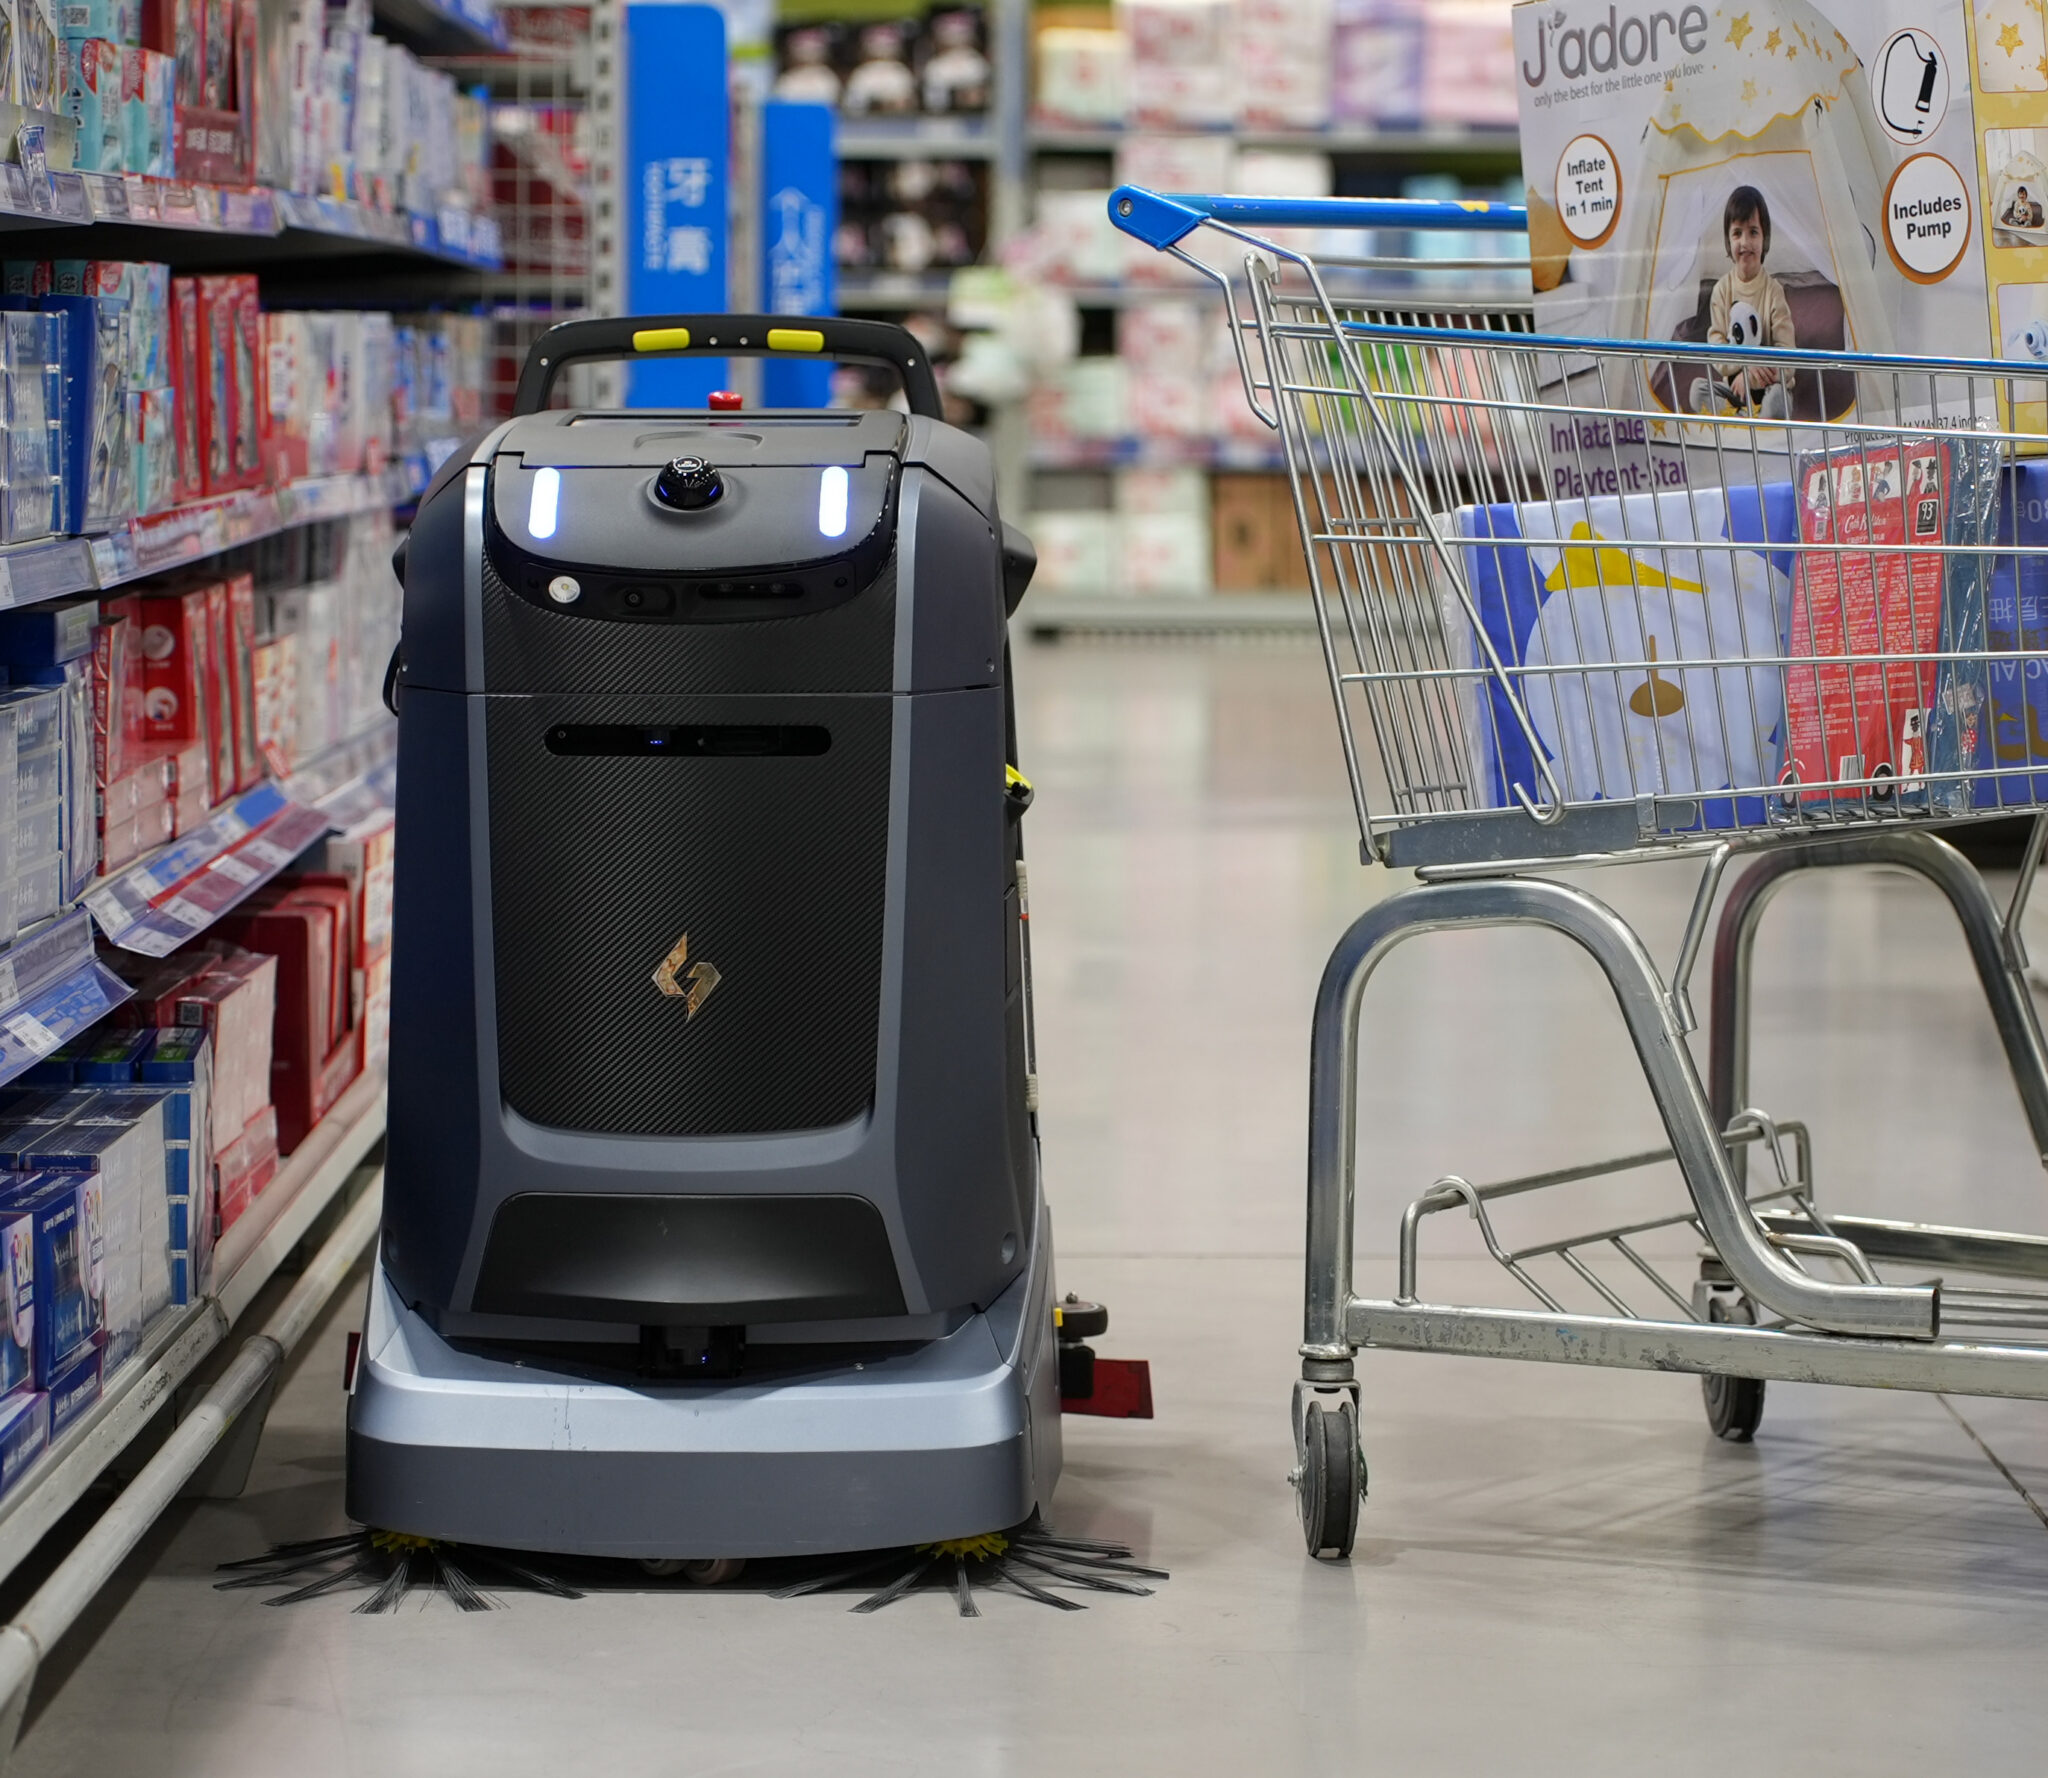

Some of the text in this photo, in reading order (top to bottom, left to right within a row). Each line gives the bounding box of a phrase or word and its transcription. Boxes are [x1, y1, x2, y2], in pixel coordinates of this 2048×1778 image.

[1523, 4, 1708, 87] J'adore
[1534, 64, 1703, 108] only the best for the little one you love
[1567, 158, 1606, 176] Inflate
[1576, 178, 1603, 195] Tent
[1566, 196, 1613, 217] in 1 min
[1894, 196, 1962, 220] Includes
[1906, 221, 1951, 240] Pump
[1550, 417, 1646, 453] Inflatable
